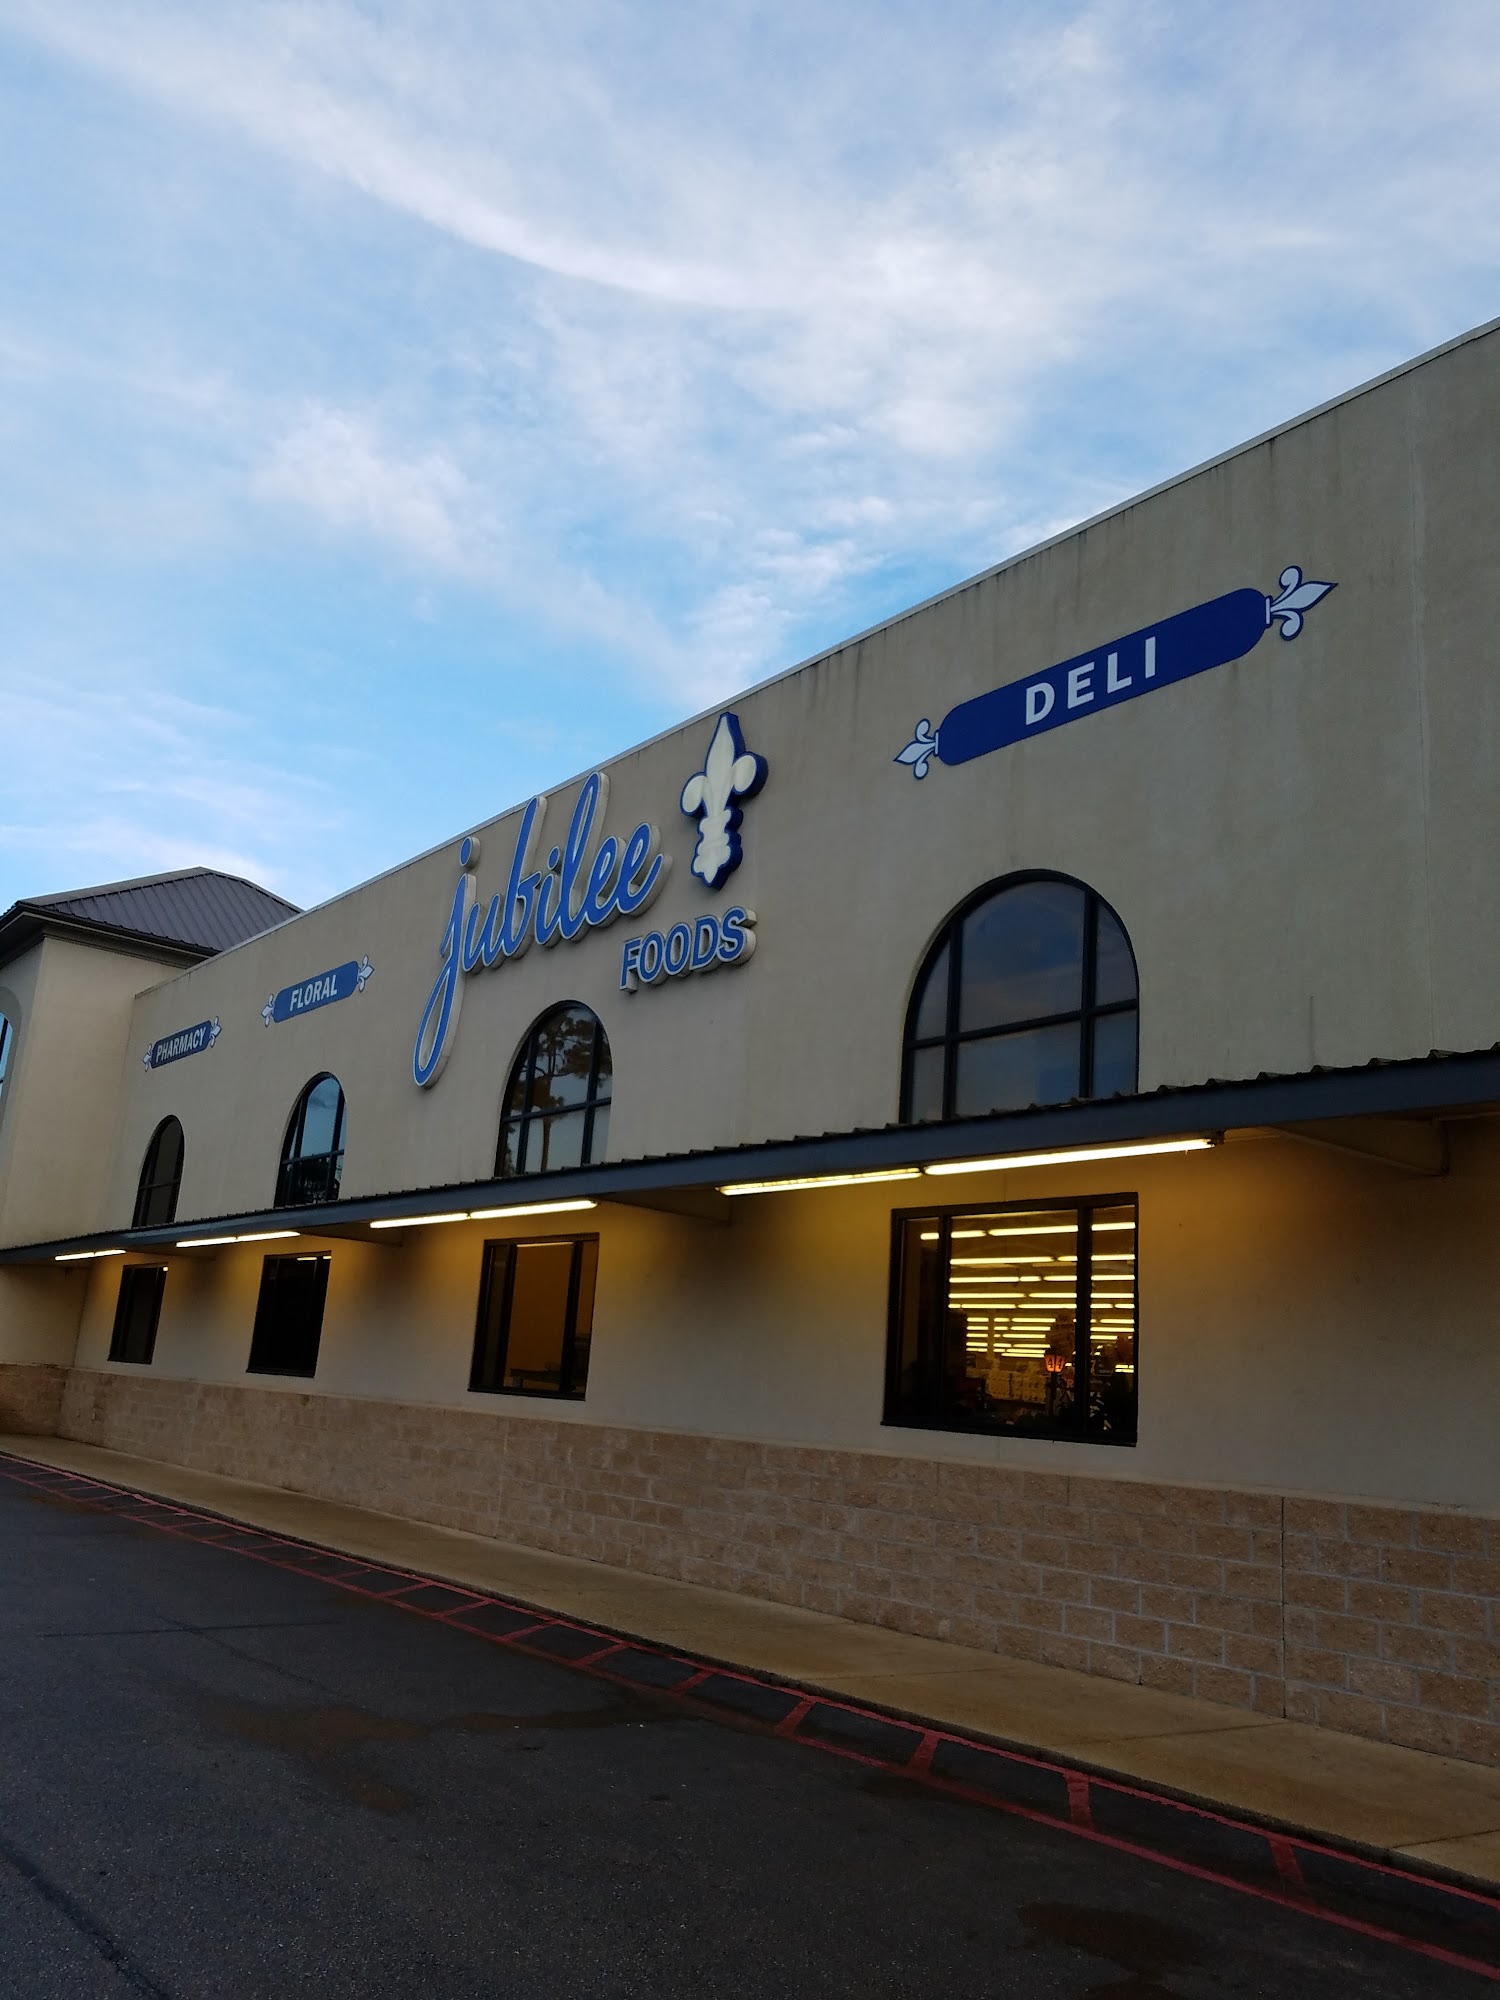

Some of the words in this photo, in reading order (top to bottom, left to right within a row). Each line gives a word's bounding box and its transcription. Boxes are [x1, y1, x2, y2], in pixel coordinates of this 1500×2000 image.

[1025, 636, 1156, 726] DELI
[414, 771, 666, 1087] jubilee
[620, 907, 754, 991] FOODS
[289, 974, 338, 1012] FLORAL
[154, 1027, 207, 1063] PHARMACY
